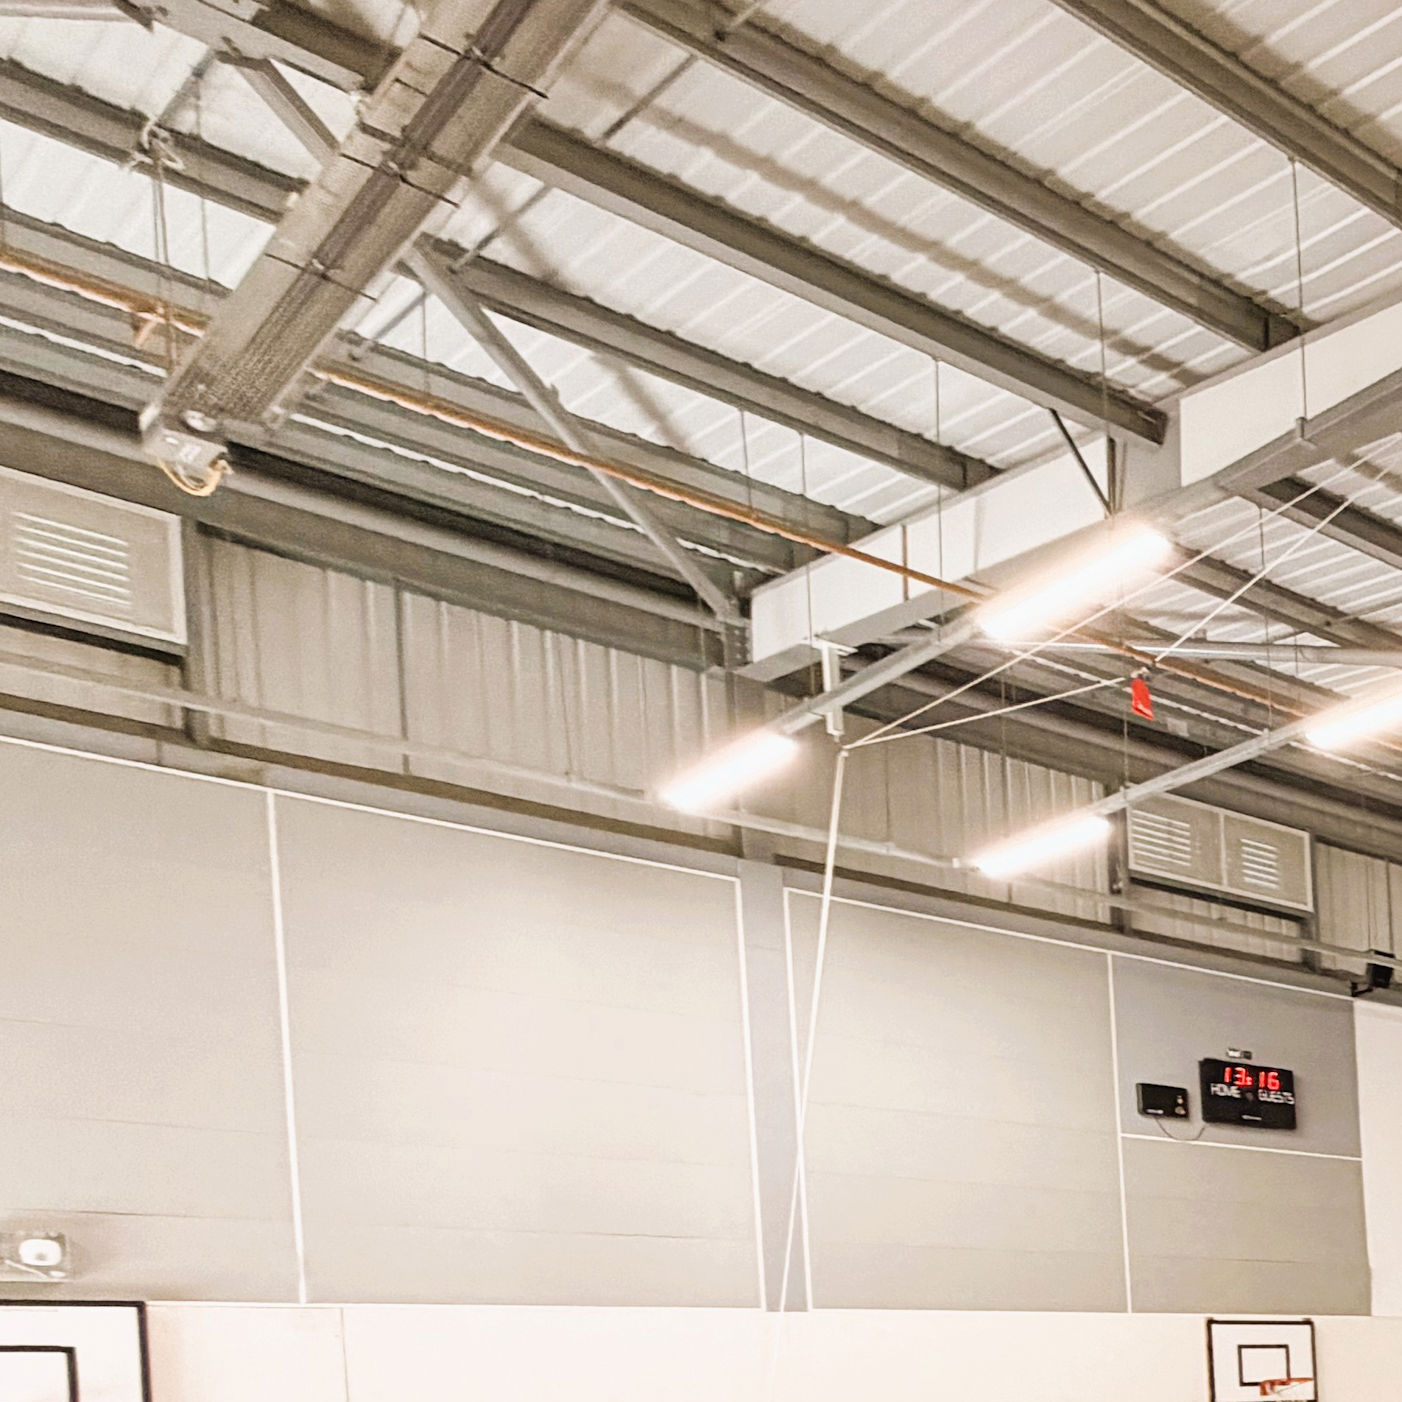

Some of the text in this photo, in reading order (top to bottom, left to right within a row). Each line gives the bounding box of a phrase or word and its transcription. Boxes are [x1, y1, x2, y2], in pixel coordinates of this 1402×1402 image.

[1224, 1067, 1281, 1091] 13:16
[1210, 1083, 1295, 1105] HOME GUESTS
